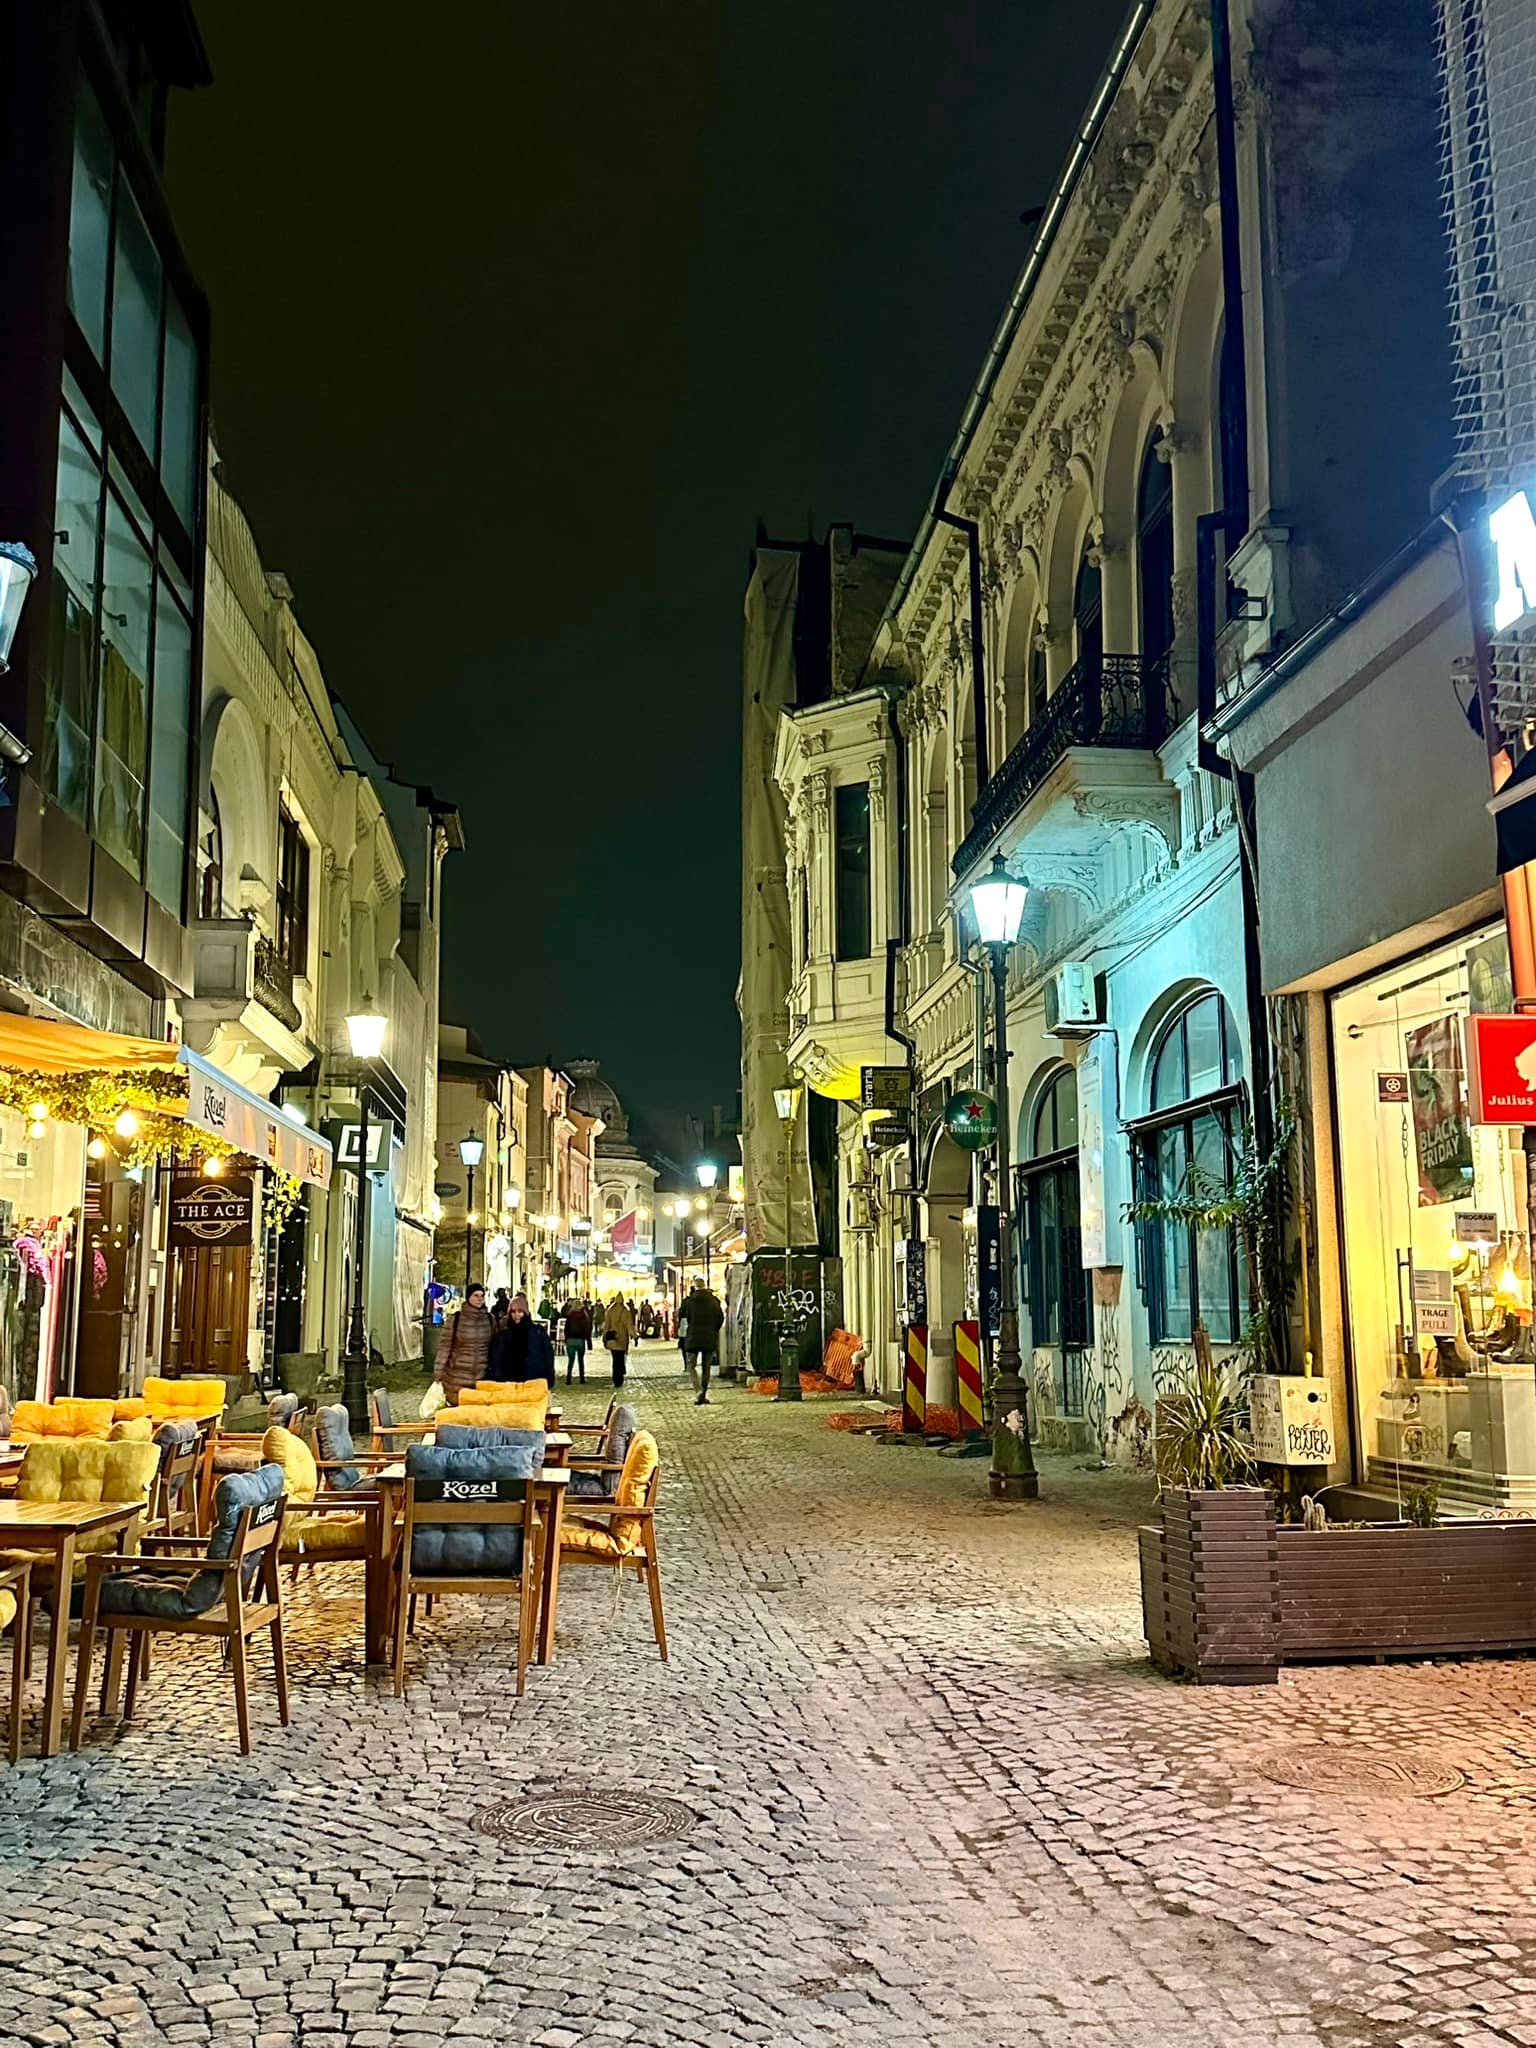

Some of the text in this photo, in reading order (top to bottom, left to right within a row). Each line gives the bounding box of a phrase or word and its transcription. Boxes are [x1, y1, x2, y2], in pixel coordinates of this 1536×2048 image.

[204, 1086, 226, 1127] Kozel
[1488, 1094, 1534, 1106] Julius
[949, 1121, 998, 1134] Heineken
[1420, 1114, 1458, 1152] BLACK
[1421, 1135, 1460, 1171] FRIDAY
[177, 1204, 245, 1217] THE ACE
[1422, 1309, 1449, 1318] TRAGE
[1422, 1320, 1449, 1330] PULL
[442, 1480, 499, 1499] Kozel
[255, 1499, 278, 1525] Kozel
